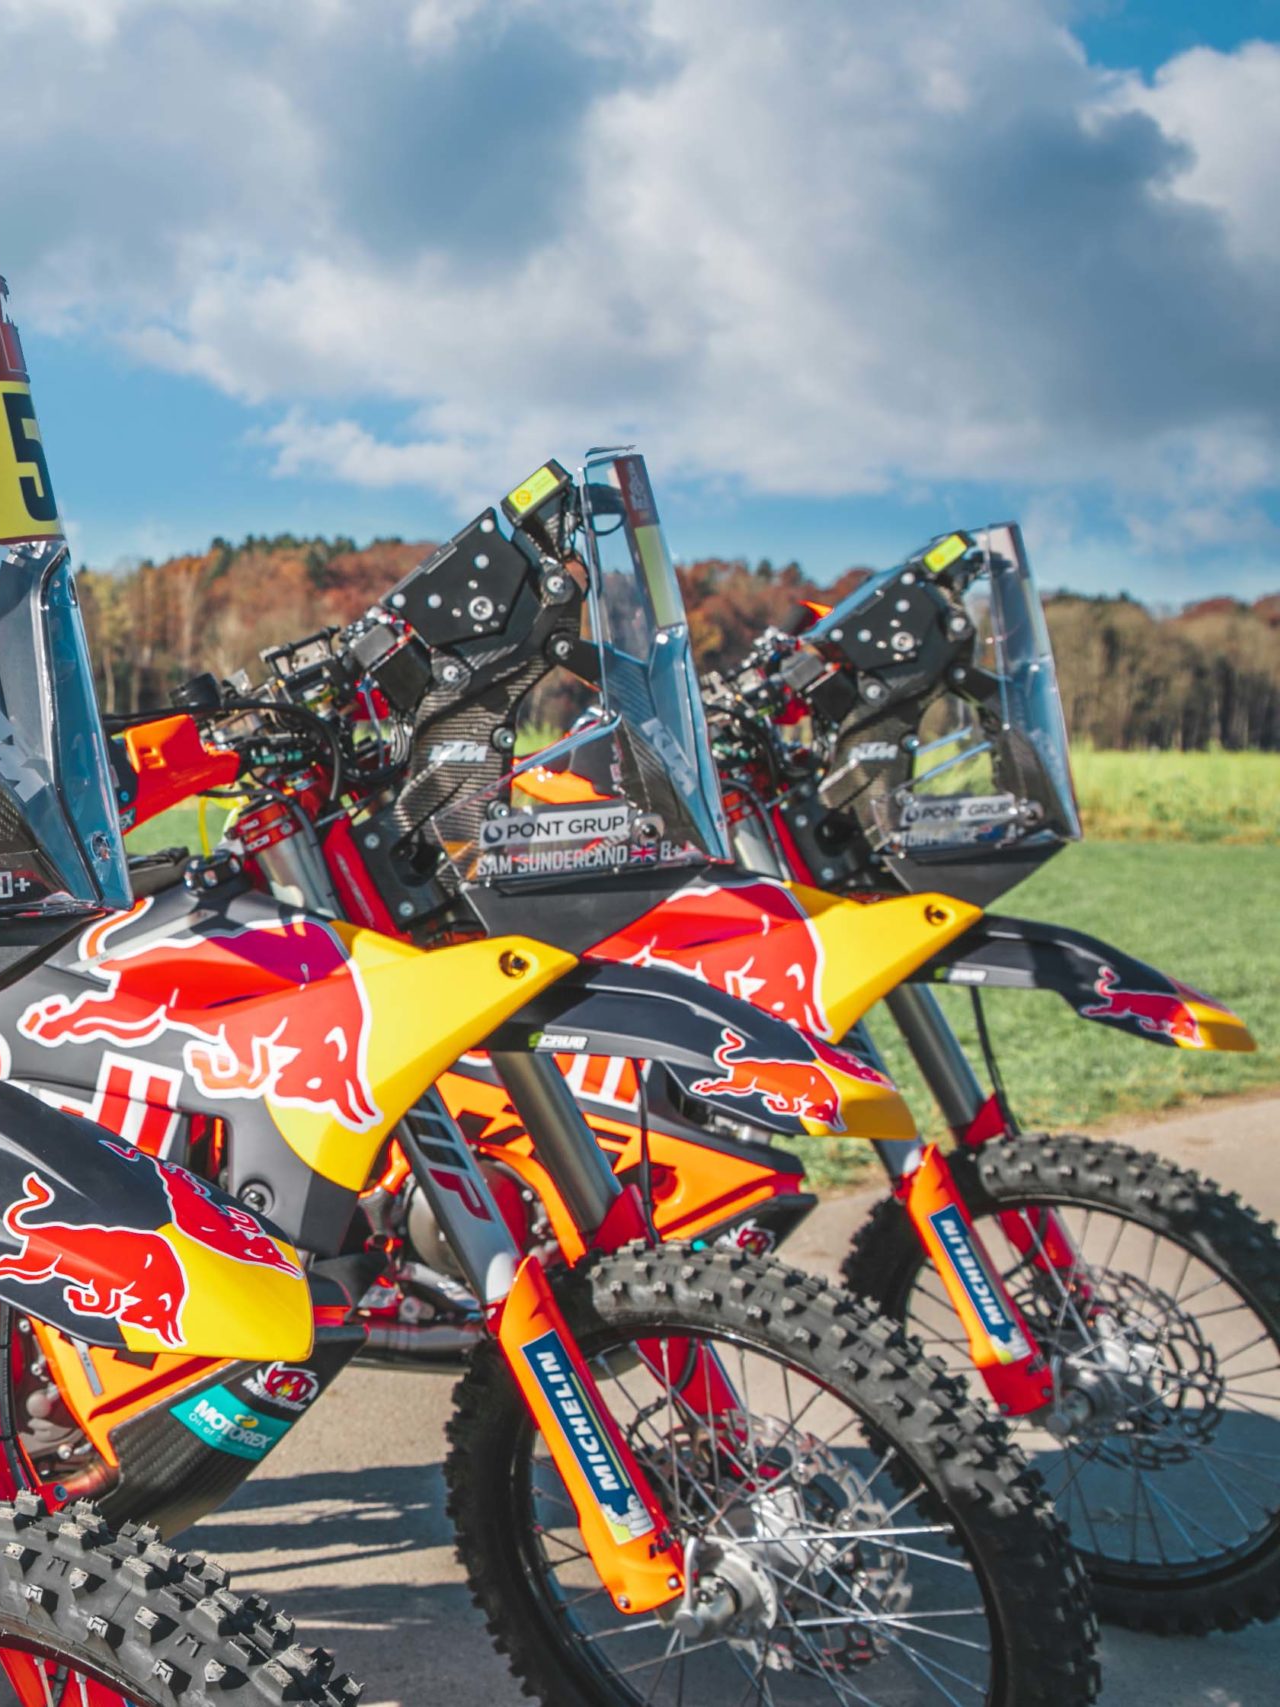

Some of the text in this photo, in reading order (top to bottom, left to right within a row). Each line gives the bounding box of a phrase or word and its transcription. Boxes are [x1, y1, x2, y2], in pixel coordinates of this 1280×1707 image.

[1, 392, 58, 521] 5
[428, 741, 488, 763] KTM
[506, 815, 625, 839] PONT GRUP
[477, 851, 513, 876] SAM
[518, 844, 628, 873] SUNDERLAND
[939, 1219, 1006, 1326] MICHELIN
[193, 1398, 274, 1449] MOTOREX
[535, 1351, 621, 1491] MICHELIN
